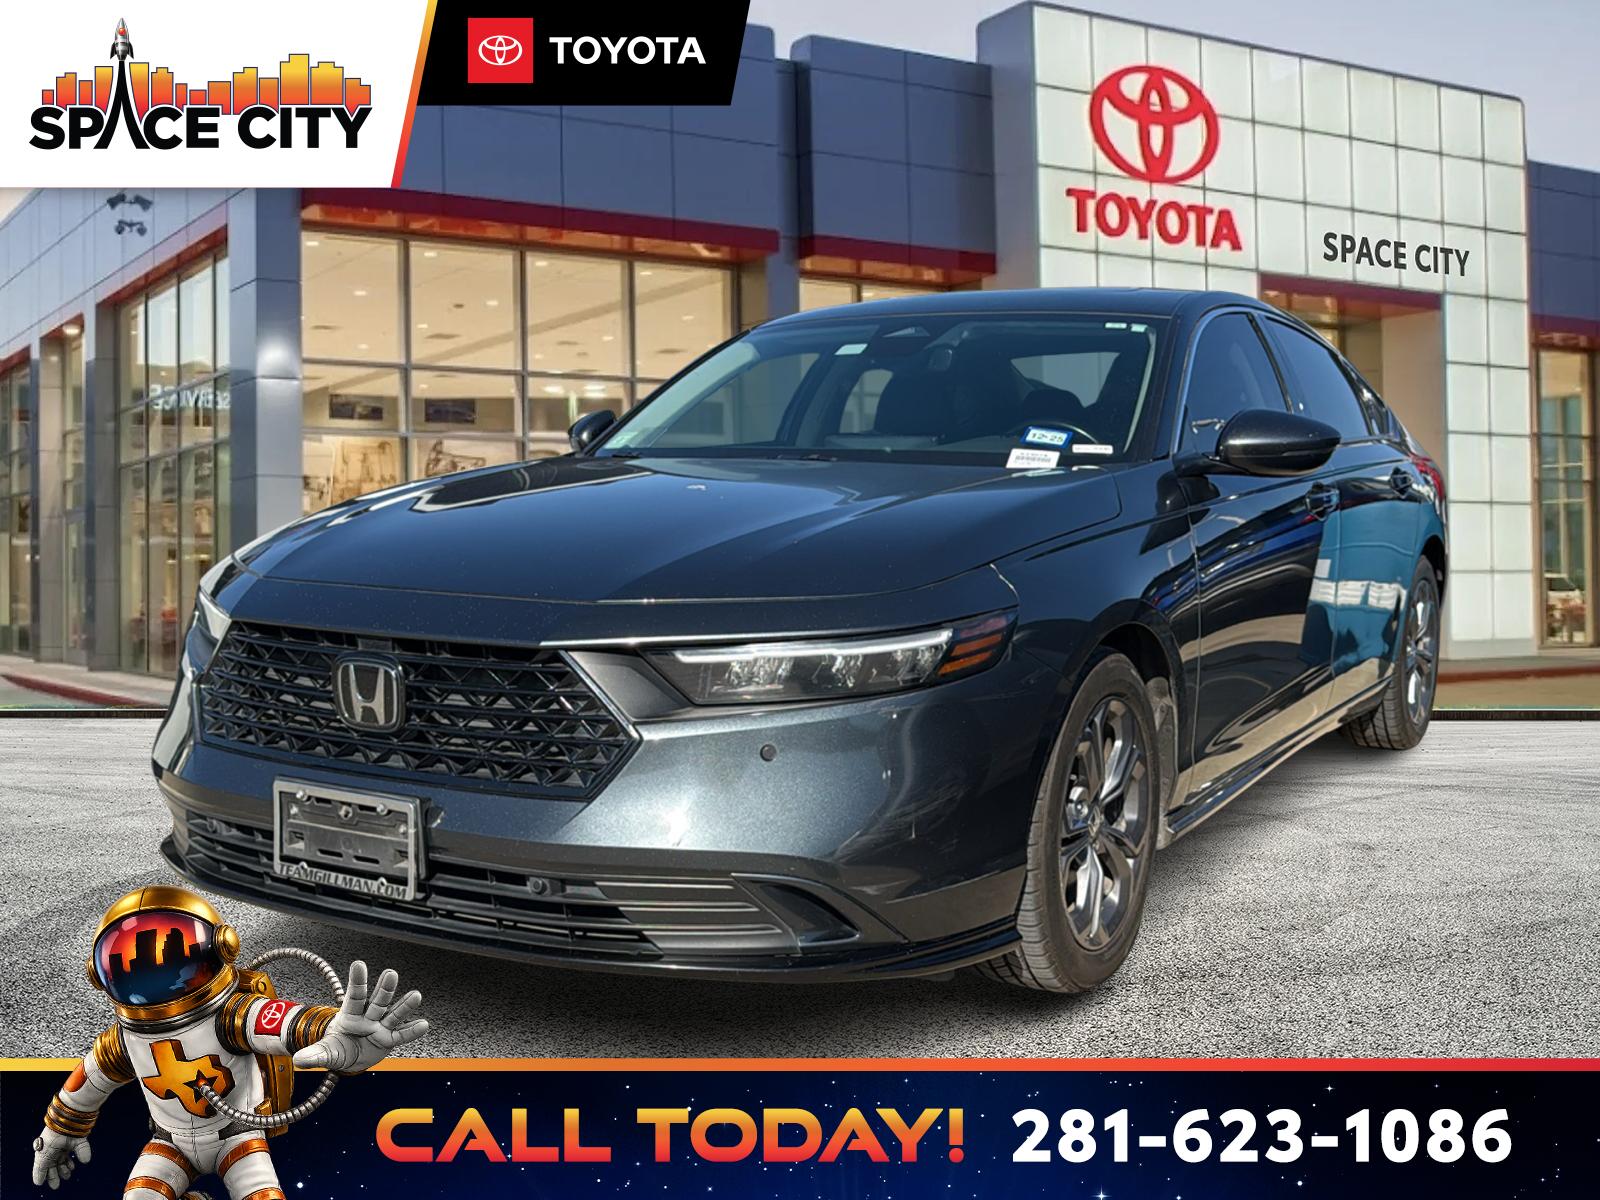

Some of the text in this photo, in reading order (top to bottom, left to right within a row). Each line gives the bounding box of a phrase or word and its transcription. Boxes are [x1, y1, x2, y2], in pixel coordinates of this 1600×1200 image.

[1066, 188, 1243, 251] TOYOTA
[1323, 232, 1470, 277] SPACE CITY
